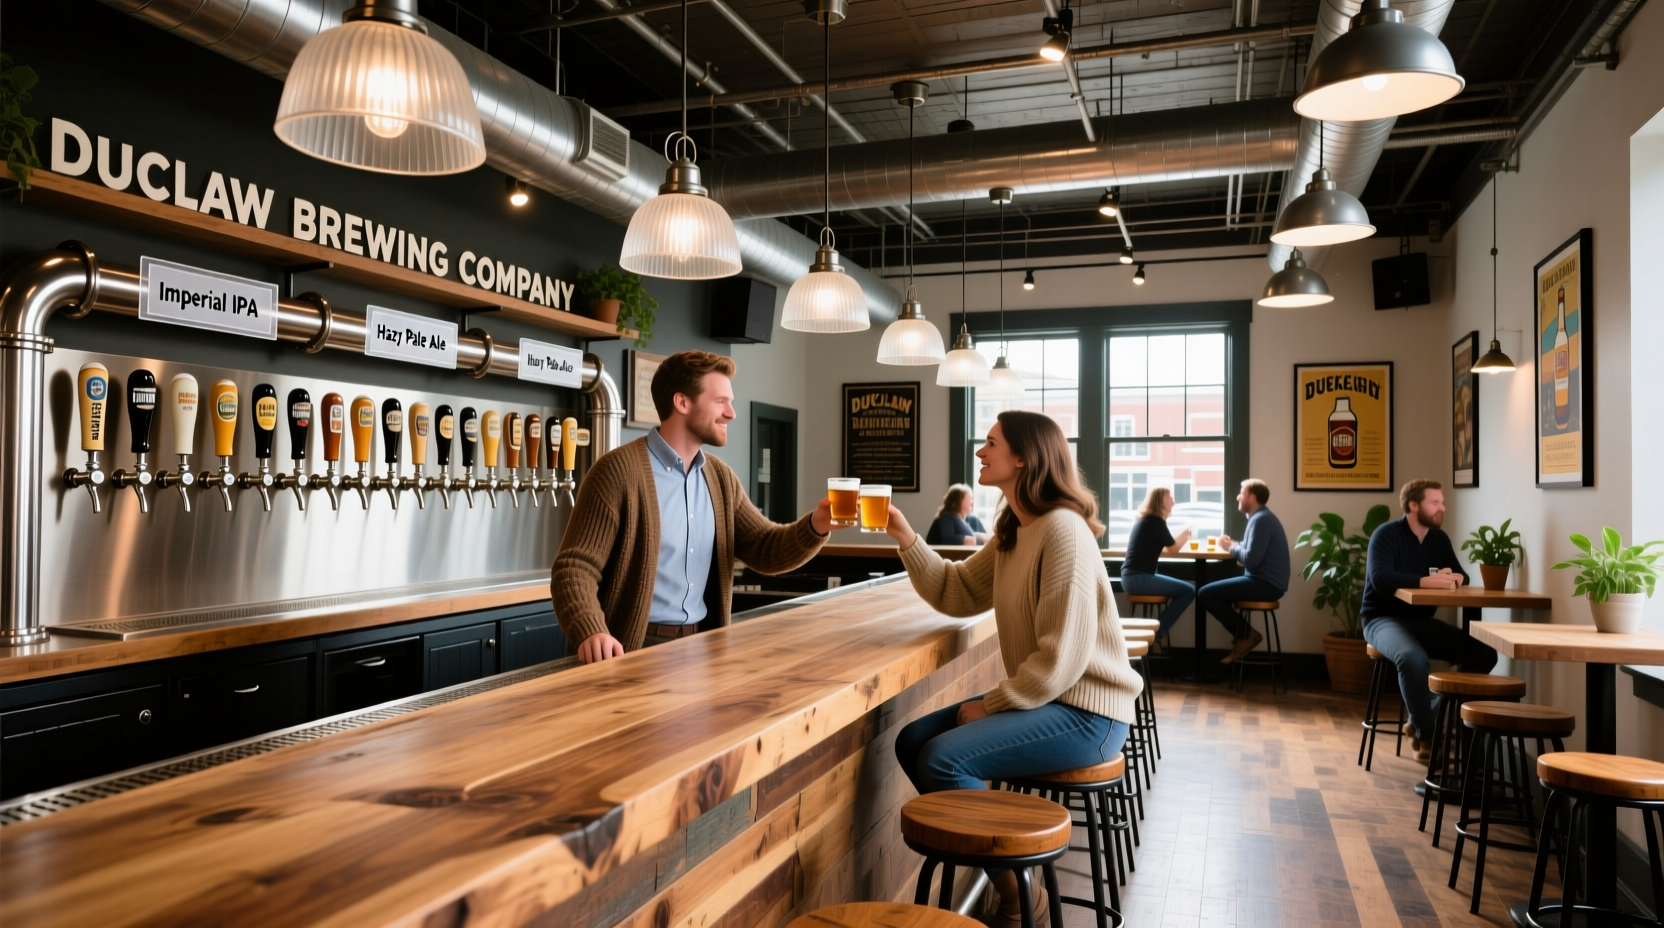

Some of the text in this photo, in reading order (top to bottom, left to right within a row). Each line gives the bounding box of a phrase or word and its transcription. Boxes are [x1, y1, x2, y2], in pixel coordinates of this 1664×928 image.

[51, 117, 575, 311] DUCLAW BREWING COMPANY
[159, 281, 258, 318] Imperial IPA
[377, 323, 446, 351] Hazy Pale Ale
